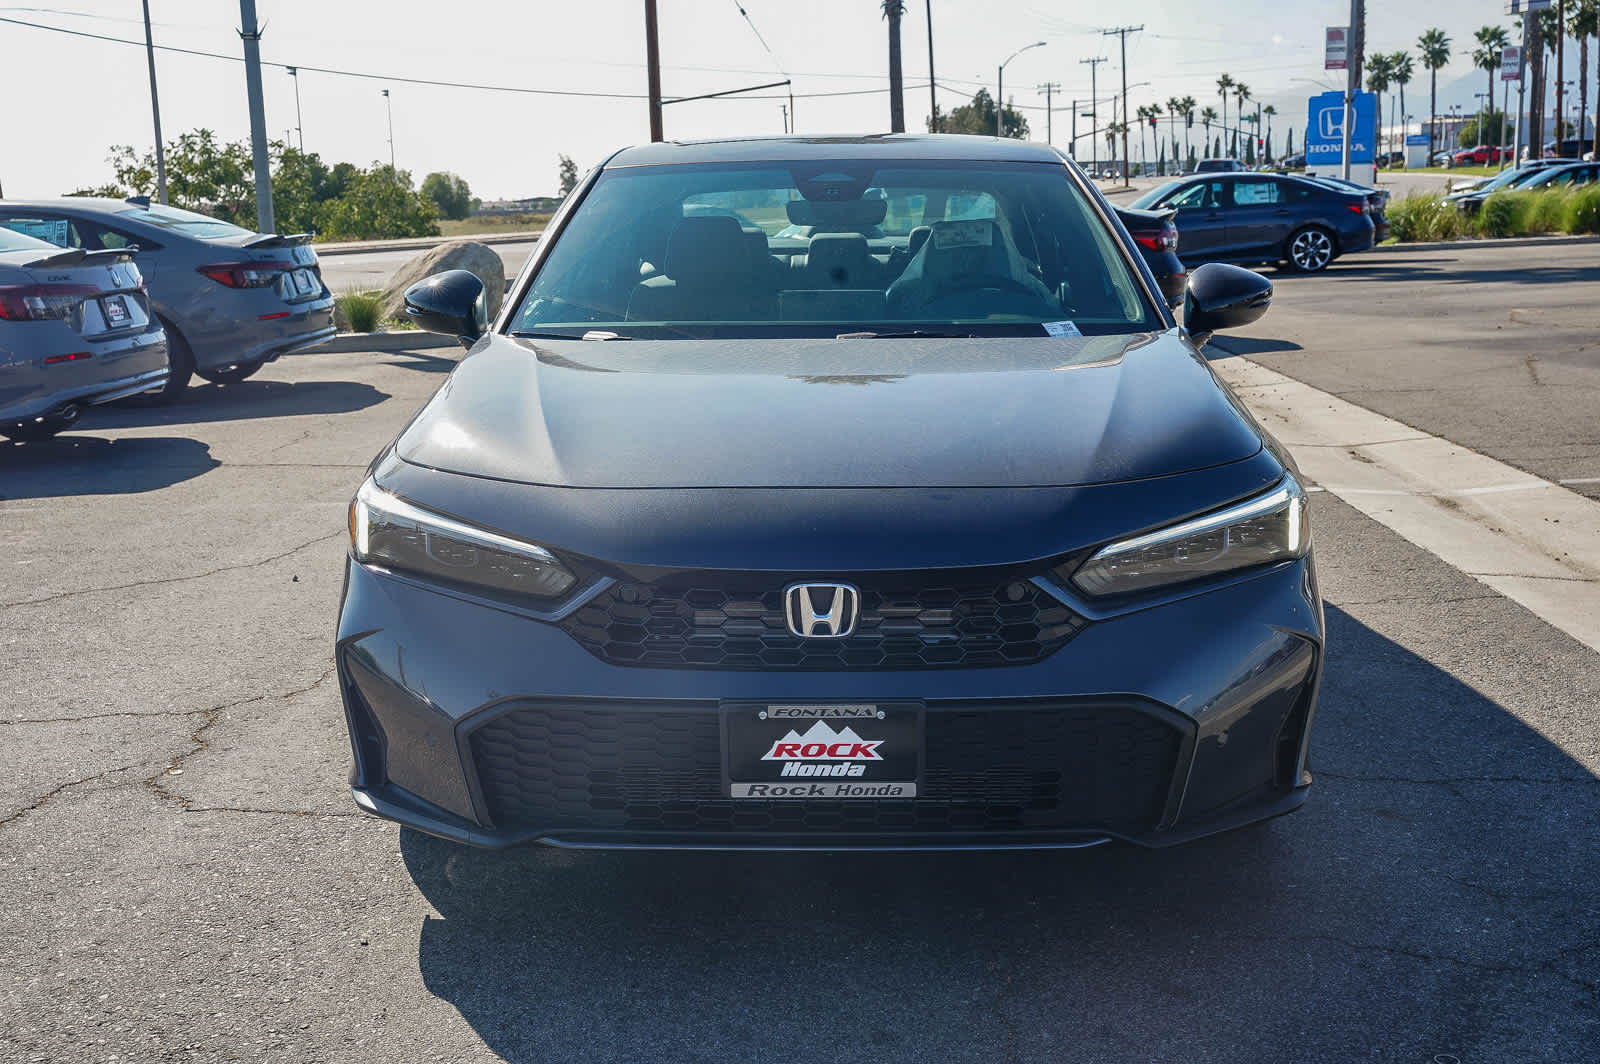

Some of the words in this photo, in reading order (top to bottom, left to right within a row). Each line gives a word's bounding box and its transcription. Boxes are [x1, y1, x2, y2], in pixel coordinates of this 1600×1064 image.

[774, 708, 873, 717] FONTANA
[772, 743, 875, 757] ROCK
[780, 762, 866, 777] Honda
[747, 785, 825, 796] Rock
[835, 785, 903, 796] Honda
